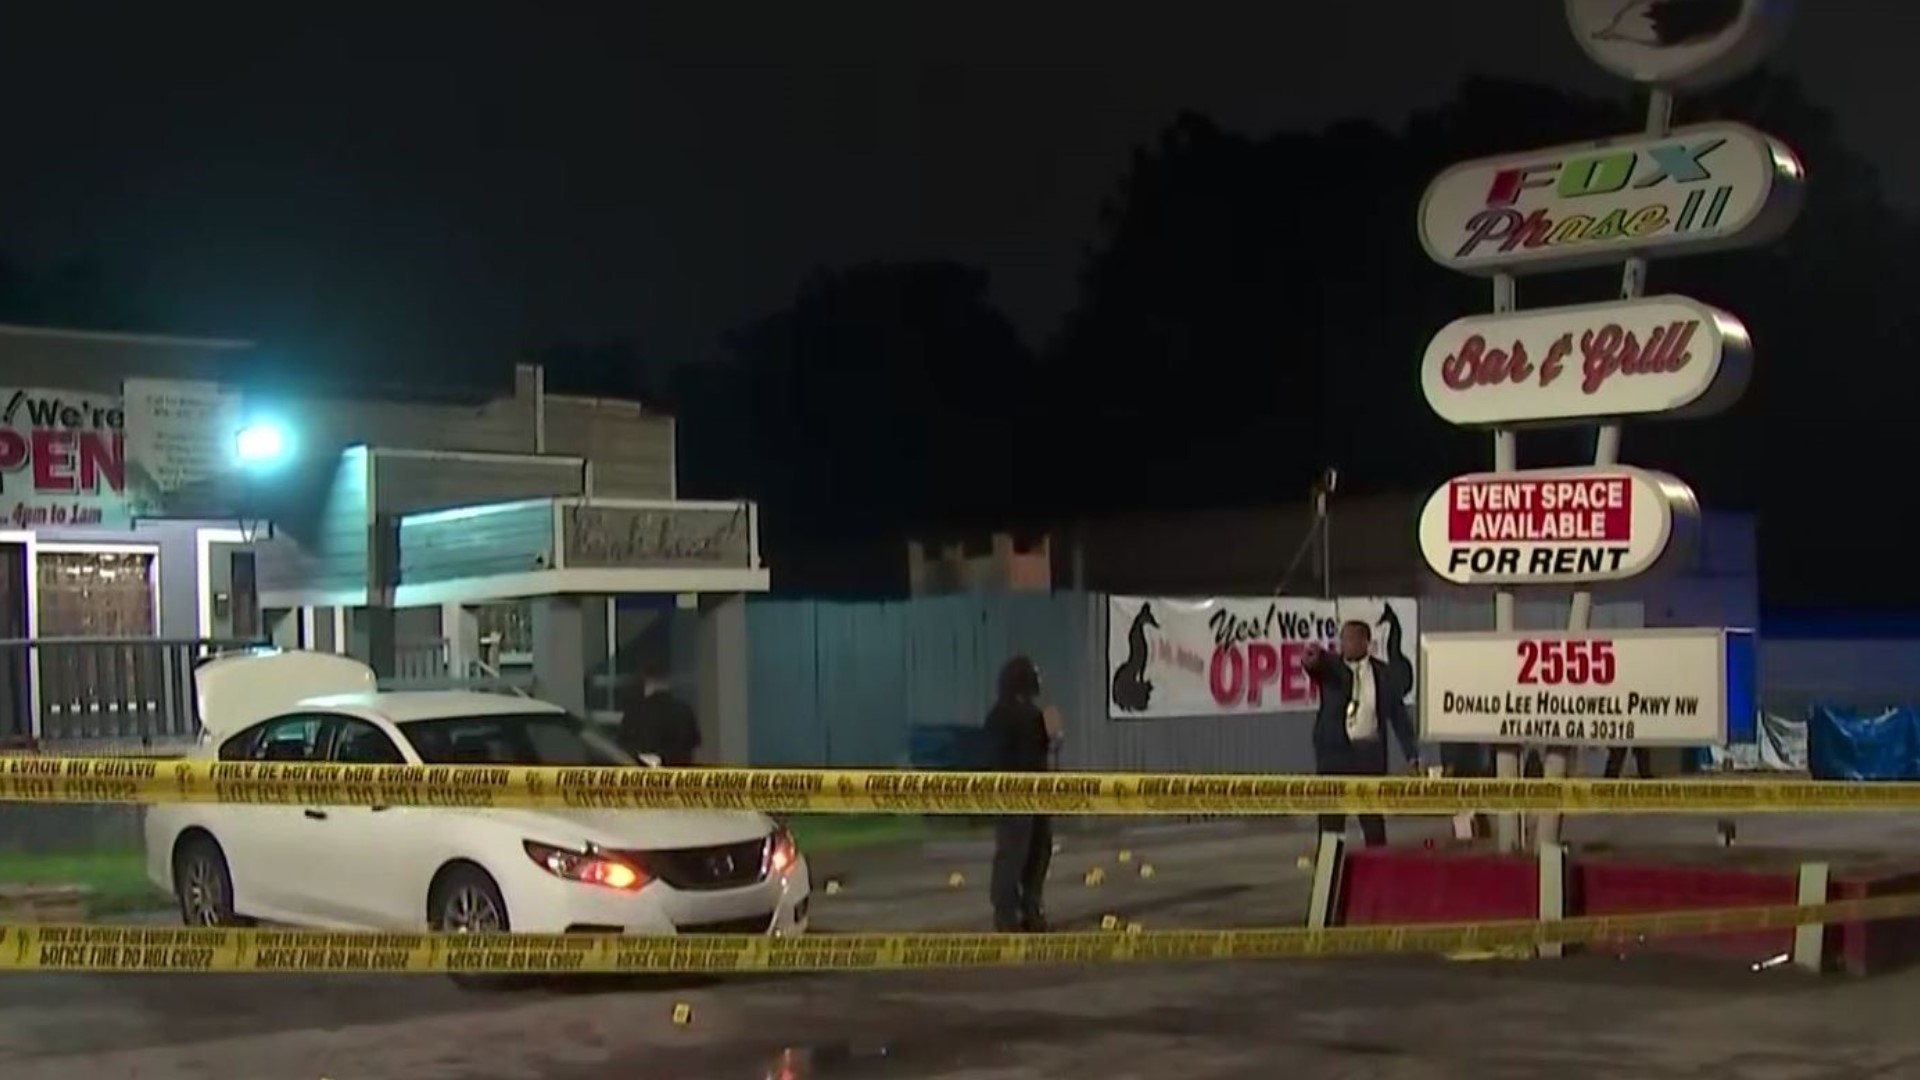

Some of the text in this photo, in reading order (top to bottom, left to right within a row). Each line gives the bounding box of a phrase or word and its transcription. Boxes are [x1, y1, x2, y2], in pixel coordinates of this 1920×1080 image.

[1486, 139, 1727, 208] FOX
[1455, 204, 1671, 258] Phase
[1442, 334, 1535, 391] Bar
[1580, 320, 1700, 396] Grill
[26, 398, 124, 429] We're
[1456, 481, 1624, 511] EVENT SPACE
[50, 502, 67, 524] to
[1469, 512, 1606, 539] AVAILABLE
[1448, 546, 1631, 574] FOR RENT
[1277, 610, 1336, 640] We're
[1208, 640, 1338, 707] OPE
[1516, 639, 1616, 686] 2555
[1675, 696, 1699, 717] NW
[1499, 719, 1635, 739] ATLANTA GA 30318
